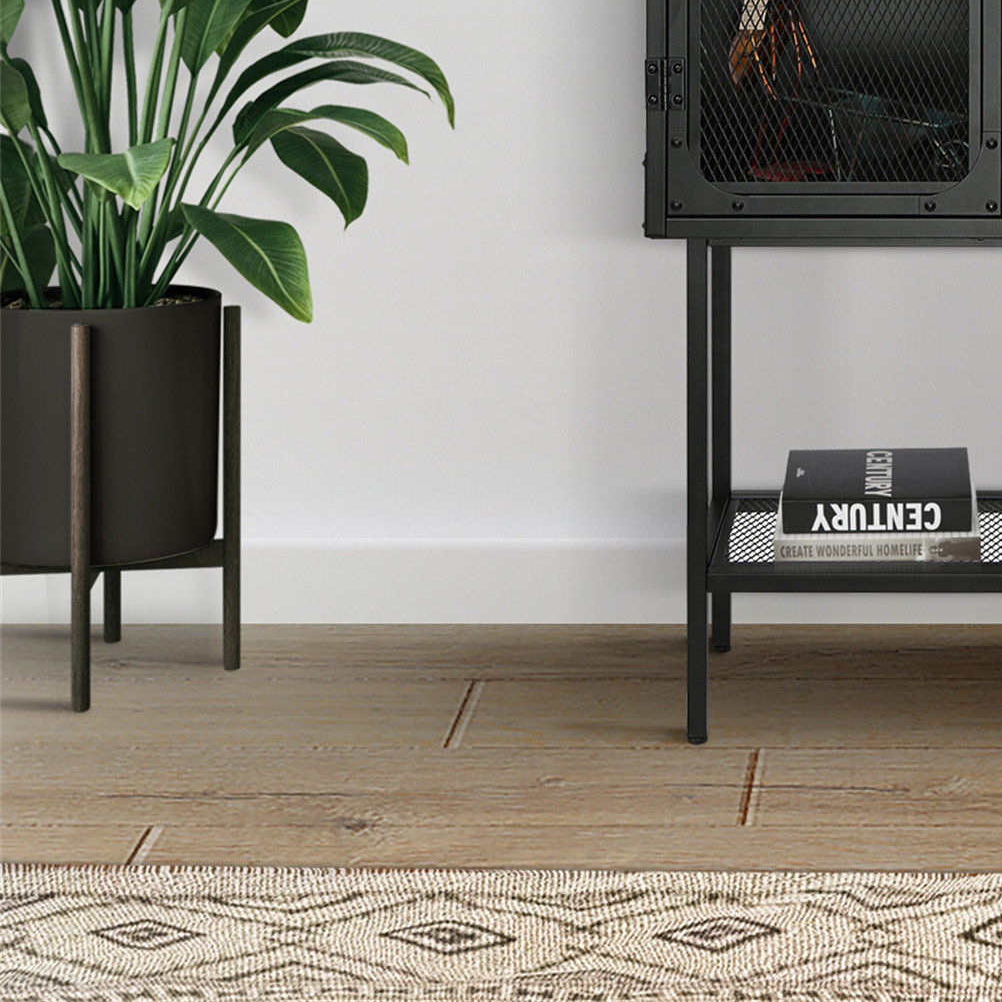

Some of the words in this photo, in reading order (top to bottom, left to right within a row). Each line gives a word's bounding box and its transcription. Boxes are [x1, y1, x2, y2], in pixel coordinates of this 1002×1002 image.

[864, 450, 893, 497] CENTURY
[811, 502, 942, 531] CENTURY
[780, 545, 817, 558] CREATE
[818, 544, 874, 558] WONDERFUL
[876, 544, 923, 557] HOMELIFE
